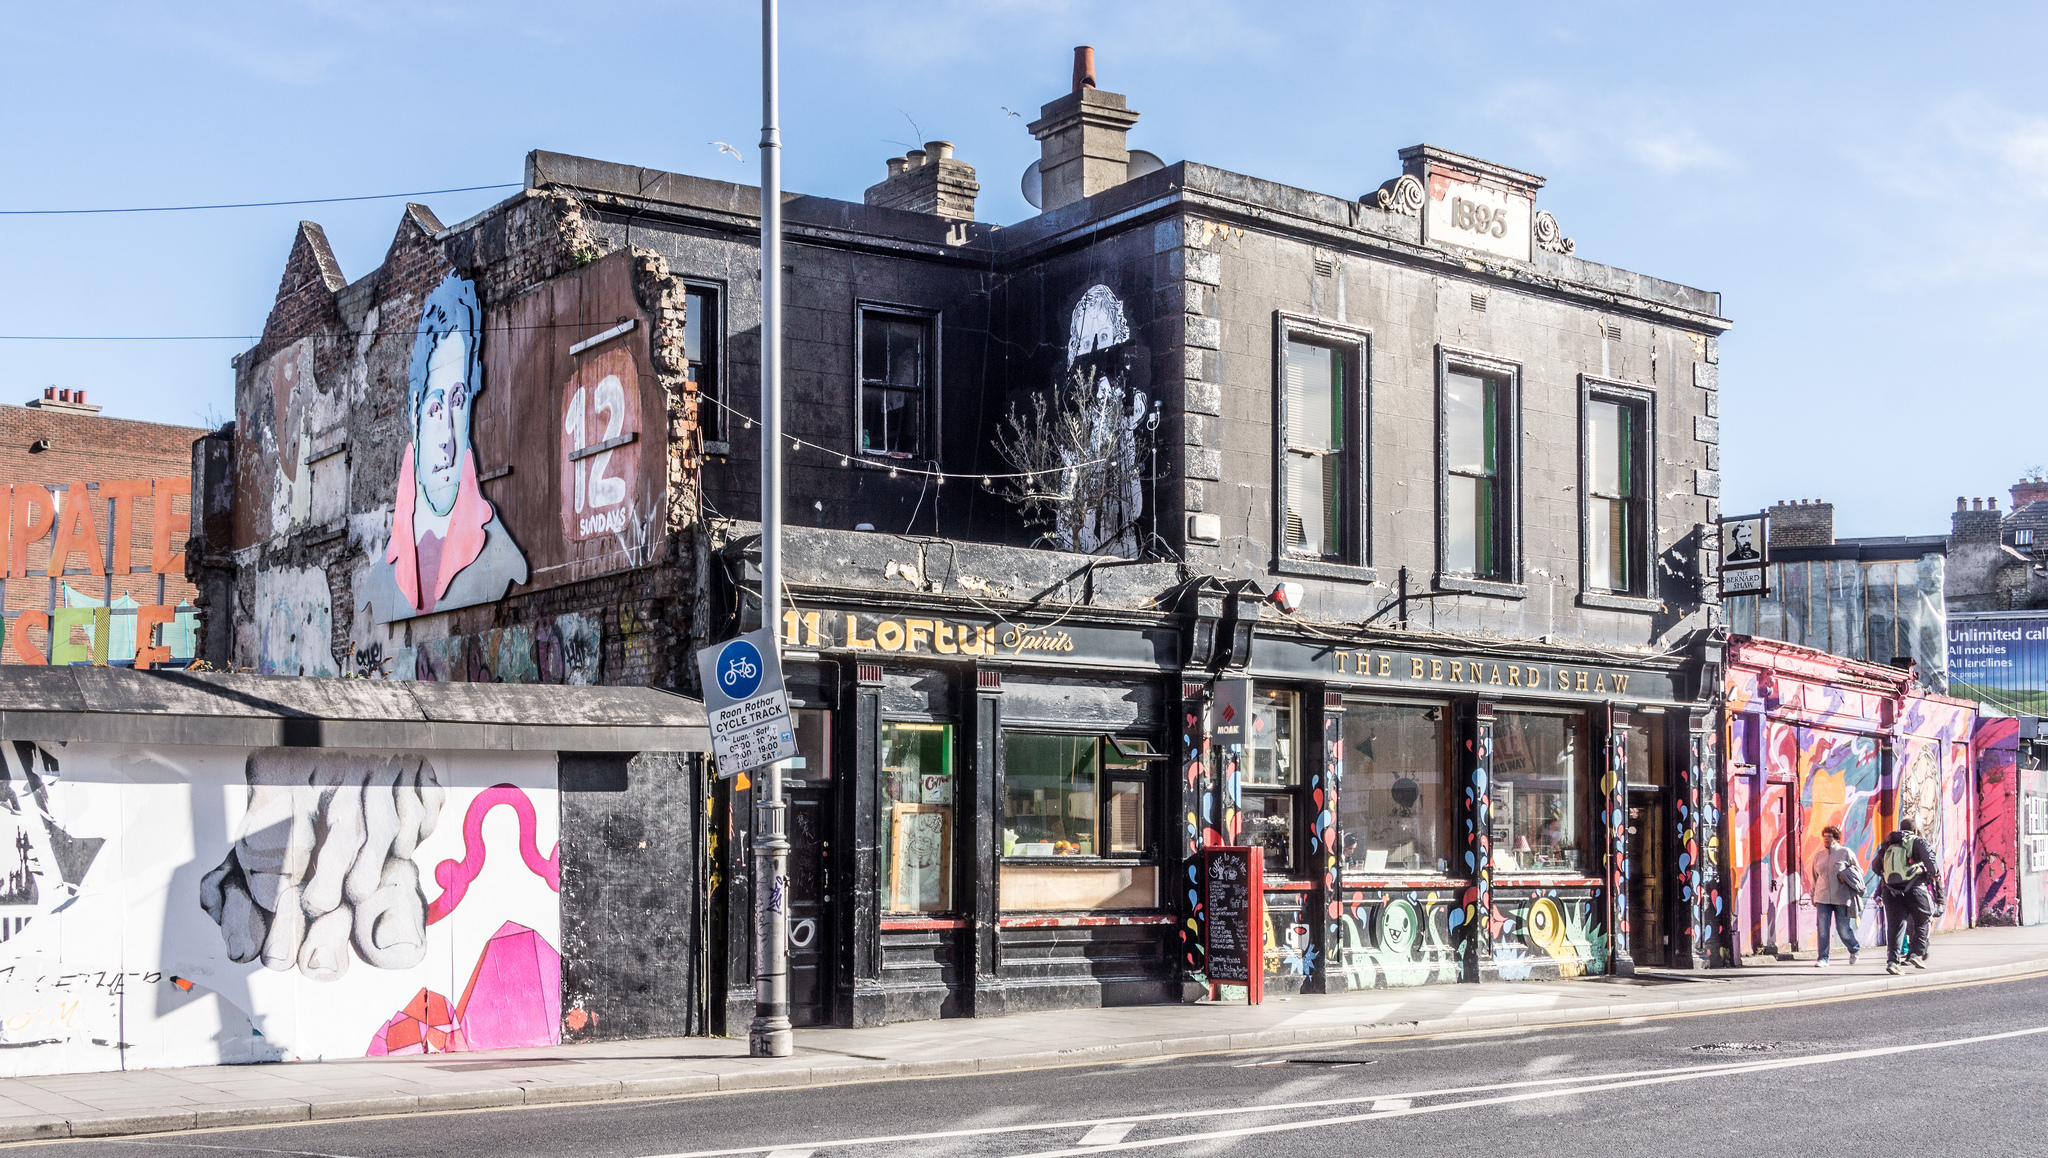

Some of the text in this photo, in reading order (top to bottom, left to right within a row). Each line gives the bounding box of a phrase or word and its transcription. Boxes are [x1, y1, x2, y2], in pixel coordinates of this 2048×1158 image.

[1452, 196, 1508, 239] 1895
[565, 374, 626, 514] 12
[580, 506, 626, 537] SUNDAYS
[1726, 574, 1760, 583] BERNARD
[1733, 581, 1755, 589] SHAW
[1002, 622, 1075, 656] Spirits
[1948, 627, 2022, 642] Unlimited
[1949, 645, 2007, 655] All mobiles
[1949, 658, 2013, 668] All landlines
[1334, 650, 1630, 695] THE BERNARD SHAW
[720, 697, 775, 721] Raon Rothar
[716, 704, 783, 733] CYCLE TRACK
[1217, 725, 1240, 735] MOAK
[757, 741, 778, 754] 19:00
[762, 751, 776, 761] SAT
